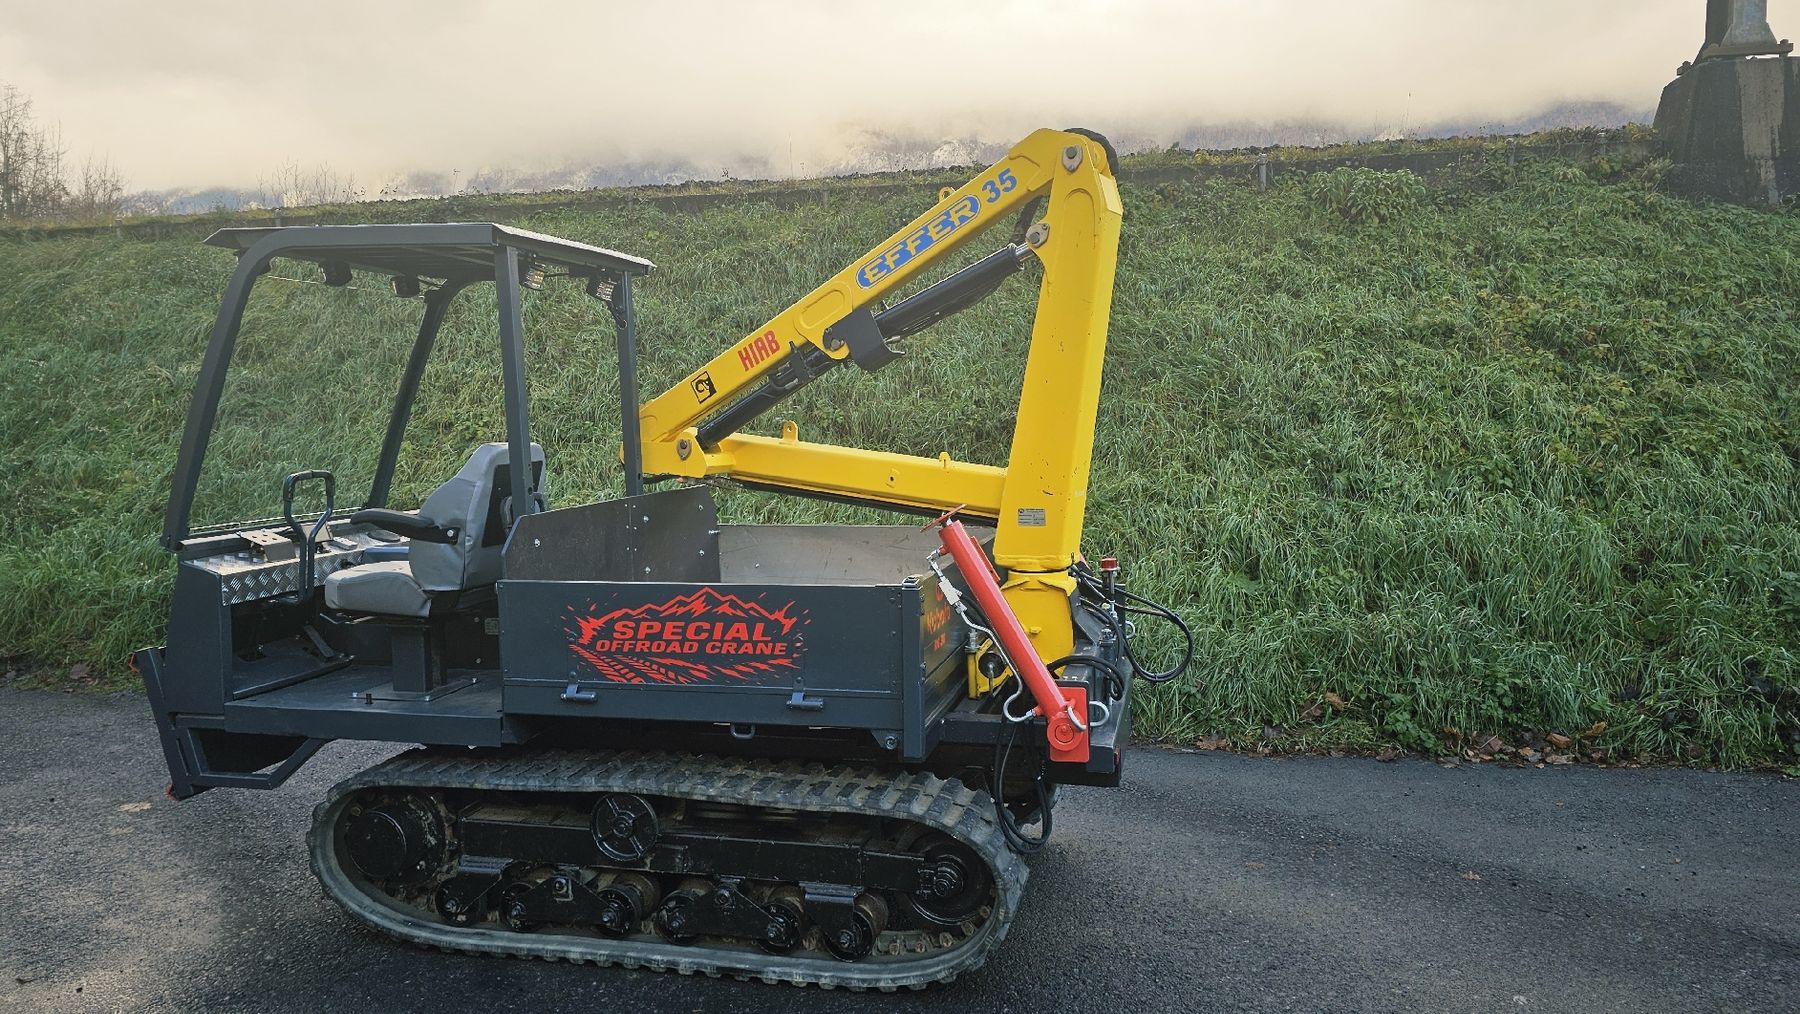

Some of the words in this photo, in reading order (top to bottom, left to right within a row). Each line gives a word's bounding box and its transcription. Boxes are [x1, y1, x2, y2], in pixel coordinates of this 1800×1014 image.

[864, 196, 975, 285] EFFER
[981, 168, 1017, 203] 35
[737, 330, 780, 372] HIAB
[612, 621, 772, 641] SPECIAL
[595, 640, 699, 653] OFFROAD
[705, 642, 787, 655] CRANE
